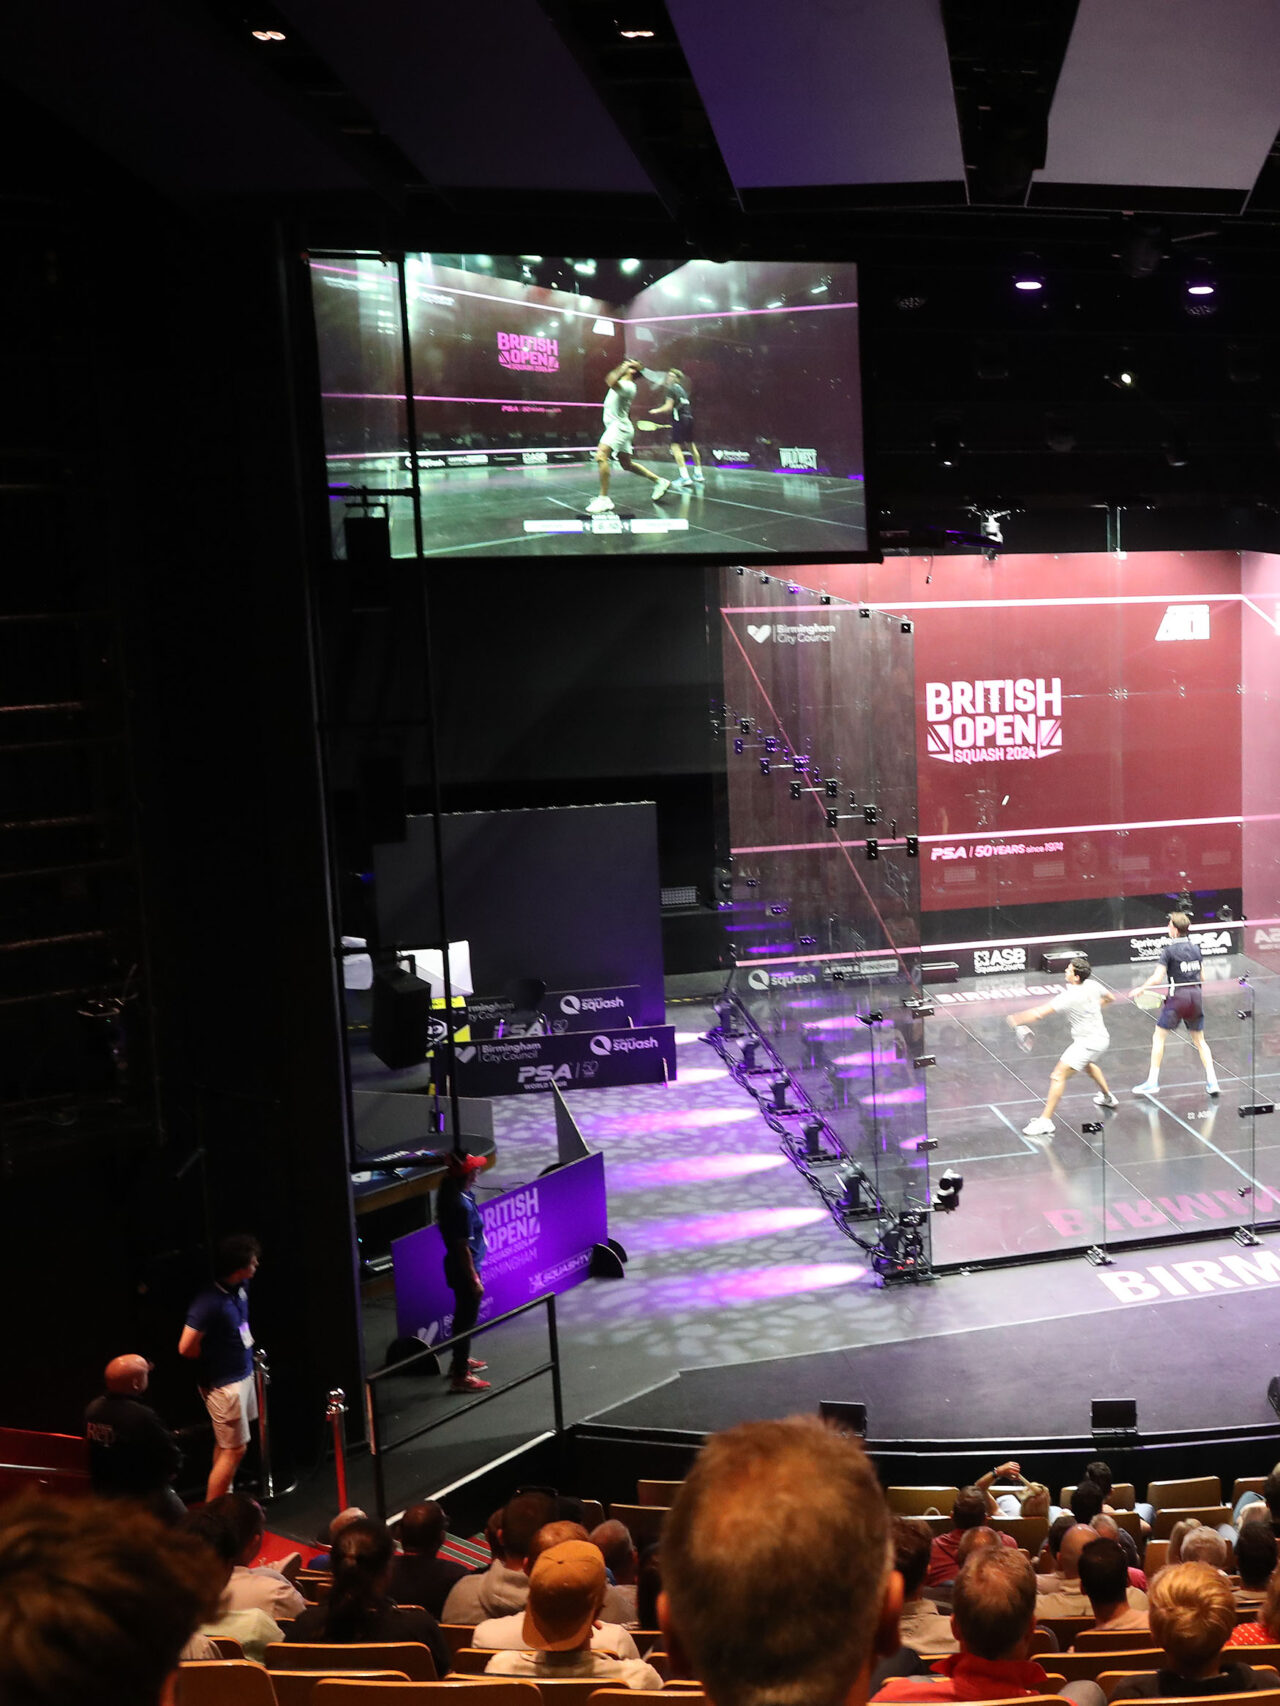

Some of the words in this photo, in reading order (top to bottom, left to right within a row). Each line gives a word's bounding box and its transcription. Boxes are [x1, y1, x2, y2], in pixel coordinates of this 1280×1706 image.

[497, 331, 559, 356] BRITISH
[510, 349, 548, 367] OPEN
[777, 624, 836, 635] Birmingham
[926, 677, 1062, 722] BRITISH
[953, 713, 1036, 748] OPEN
[955, 748, 1005, 765] SQUASH
[1005, 746, 1036, 761] 2024
[931, 846, 967, 861] PSA
[975, 845, 993, 858] 50
[992, 844, 1025, 856] YEARS
[1188, 931, 1232, 949] PSA
[990, 947, 1026, 967] ASB
[771, 973, 816, 988] squash
[468, 1002, 514, 1015] rmingham
[581, 997, 624, 1013] squash
[482, 1042, 542, 1054] Birmingham
[613, 1037, 658, 1053] squash
[482, 1053, 499, 1064] City
[502, 1051, 538, 1062] Council
[517, 1063, 572, 1083] PSA
[479, 1186, 540, 1232] RITISH
[487, 1216, 527, 1254] OPEN
